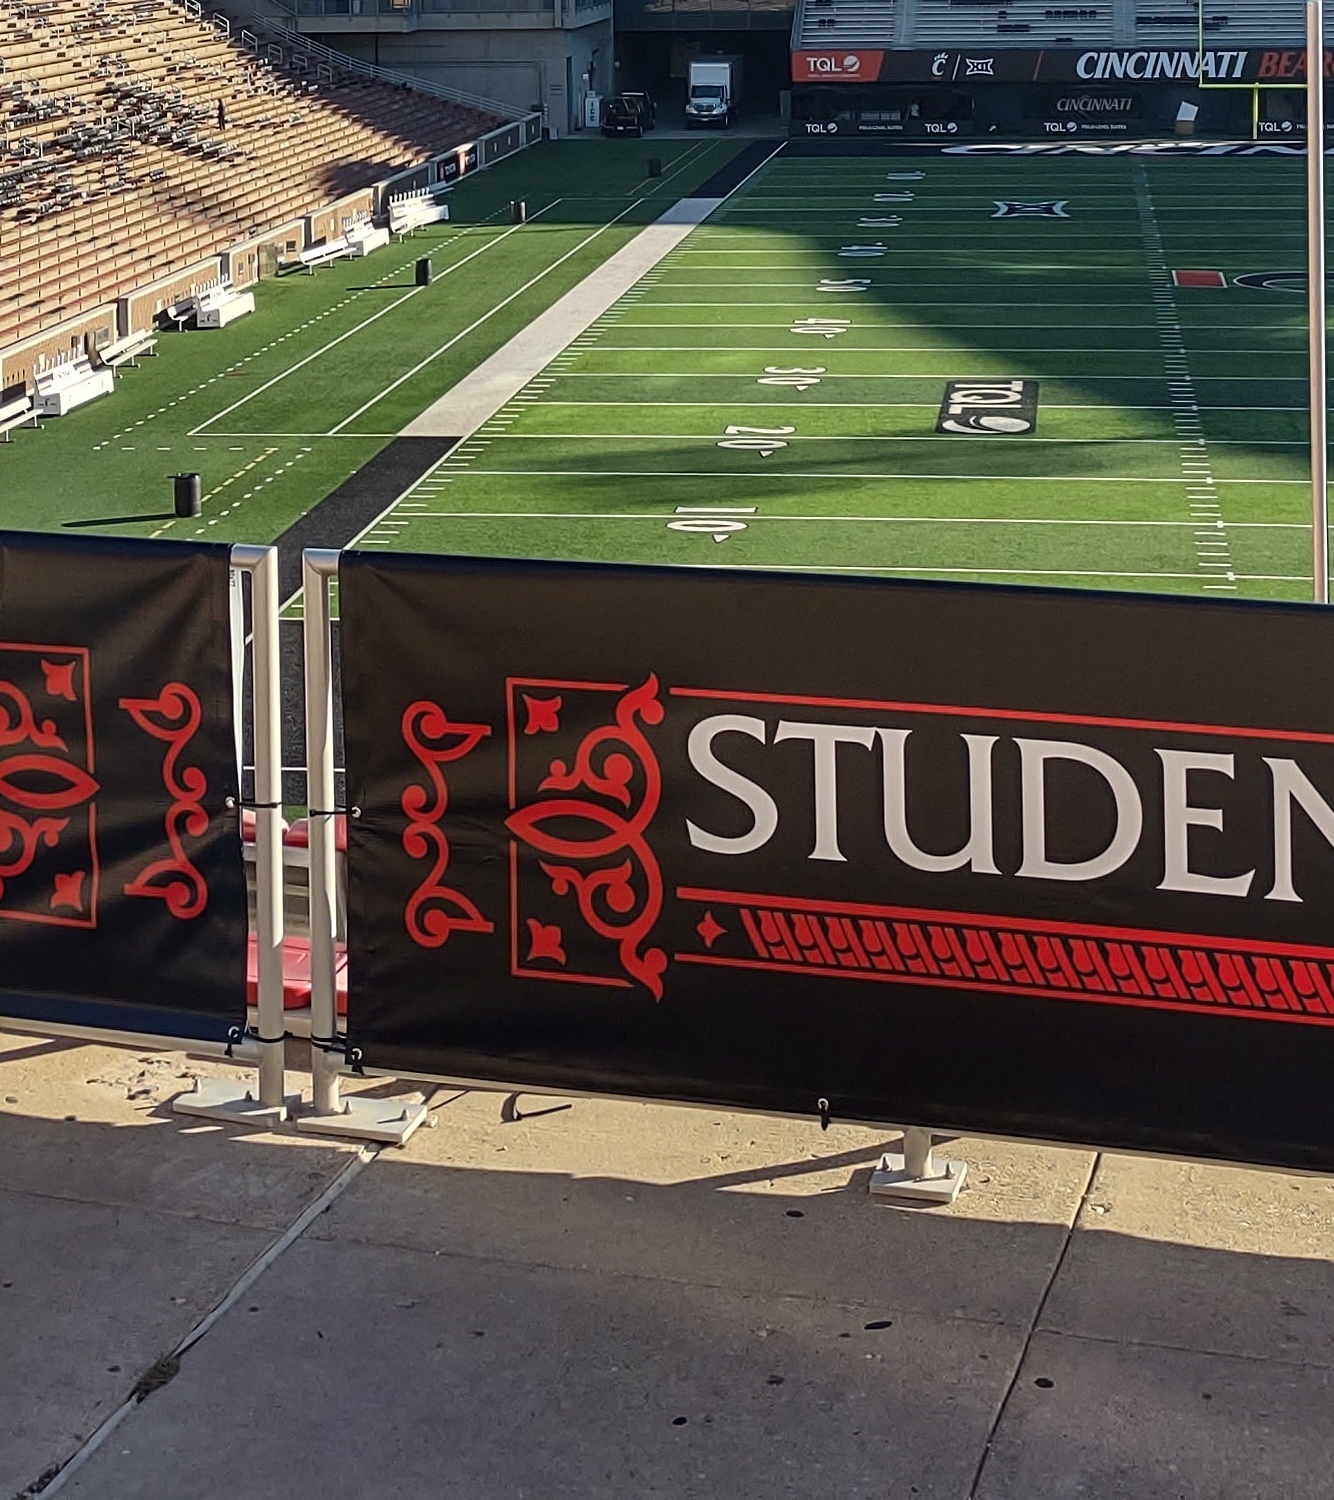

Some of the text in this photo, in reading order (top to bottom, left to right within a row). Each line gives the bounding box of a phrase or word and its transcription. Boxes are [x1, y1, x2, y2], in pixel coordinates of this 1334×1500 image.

[806, 56, 843, 72] TQL
[1076, 50, 1248, 80] CINCINNATI
[1056, 97, 1133, 112] CINCINNATI
[805, 123, 827, 134] TQL
[924, 123, 947, 133] TQL
[1043, 122, 1067, 132] TQL
[1258, 122, 1281, 132] TQL
[789, 317, 852, 335] 40
[756, 365, 827, 388] 30
[948, 380, 1023, 416] TQL
[715, 424, 797, 450] 20
[666, 506, 759, 533] 10
